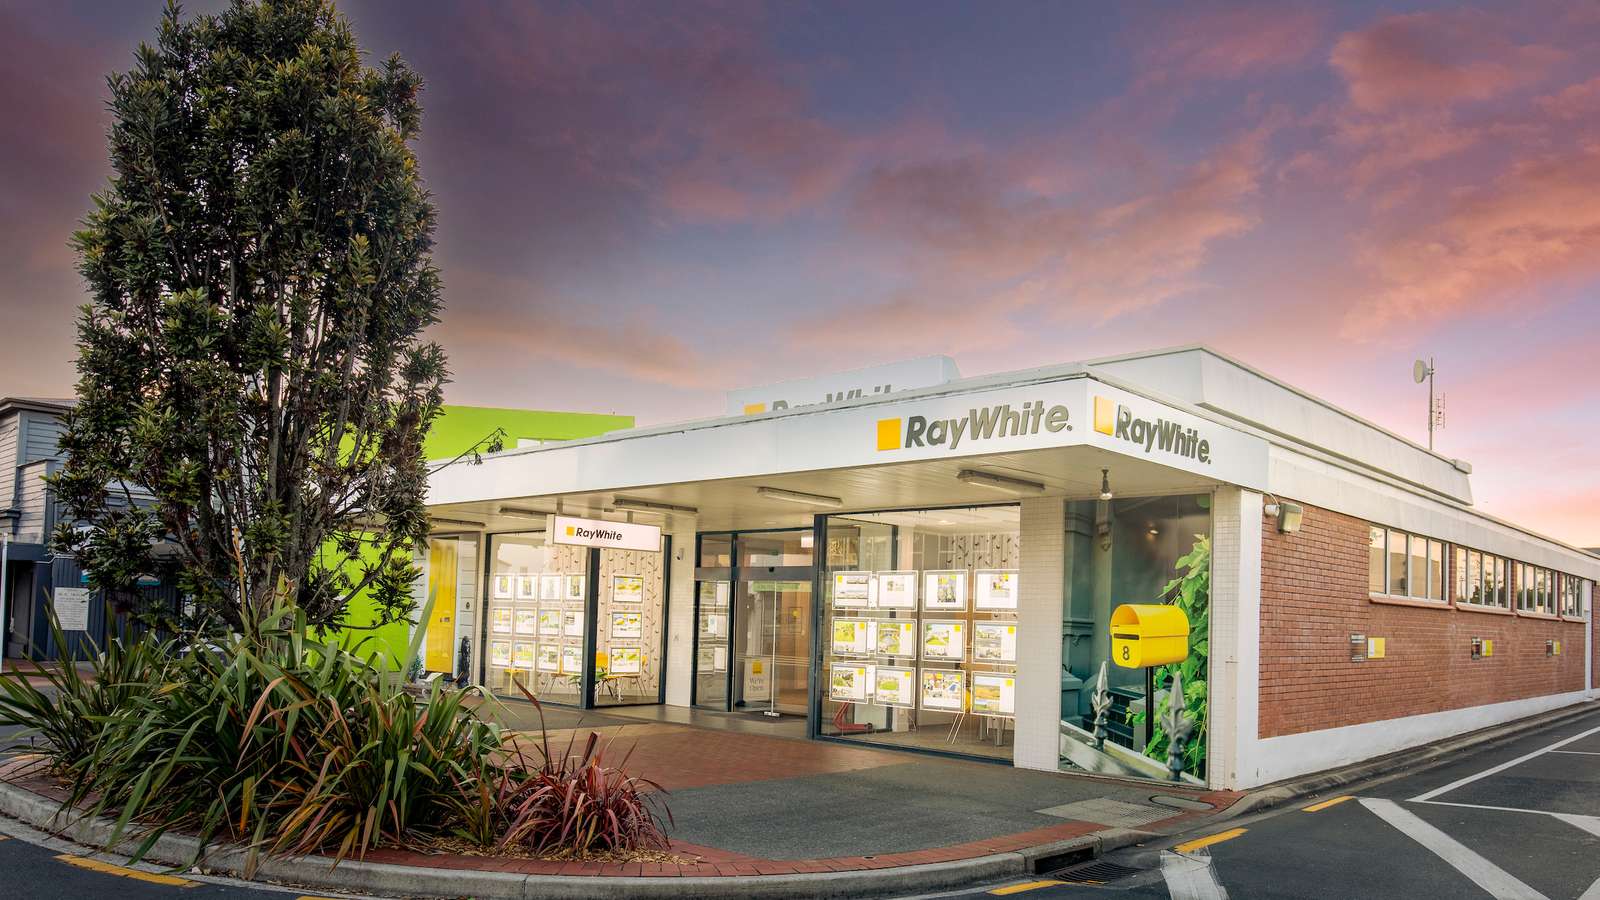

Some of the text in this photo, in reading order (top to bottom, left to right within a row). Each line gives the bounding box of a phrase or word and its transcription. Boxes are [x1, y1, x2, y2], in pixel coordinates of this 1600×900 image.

[905, 400, 1073, 449] RayWhite.
[1115, 404, 1211, 464] RayWhite.
[576, 527, 622, 540] RayWhite
[1122, 646, 1129, 660] 8
